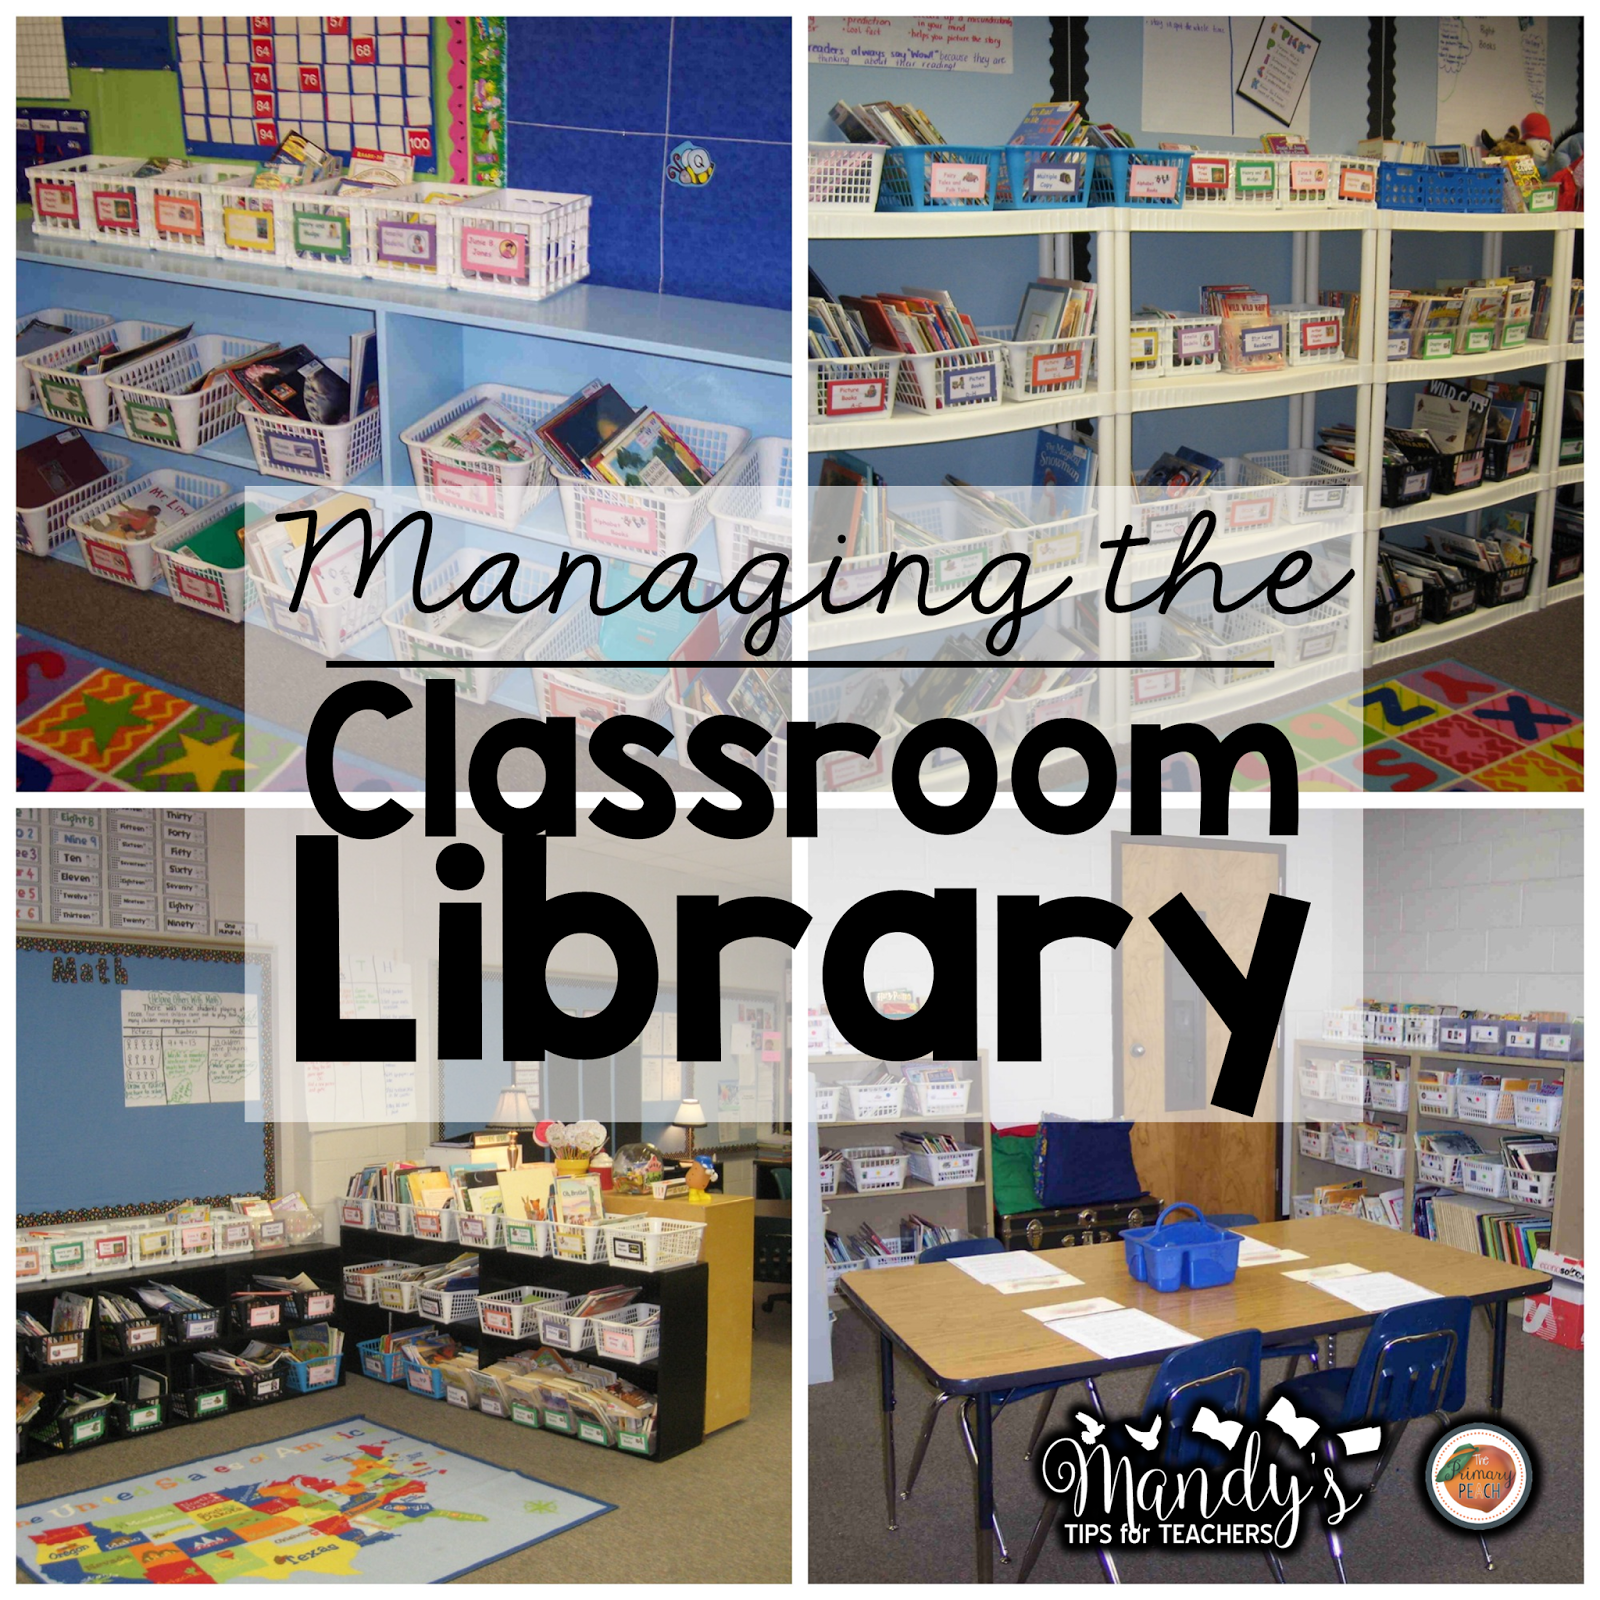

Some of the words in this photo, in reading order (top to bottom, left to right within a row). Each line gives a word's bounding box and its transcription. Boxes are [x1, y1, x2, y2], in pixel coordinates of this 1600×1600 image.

[927, 22, 943, 31] your
[948, 23, 966, 32] mind
[931, 34, 944, 43] you
[255, 45, 271, 58] 64
[356, 44, 372, 57] 68
[808, 43, 844, 55] readers
[851, 46, 886, 60] always
[891, 49, 907, 62] say
[939, 52, 969, 63] because
[973, 53, 990, 67] they
[993, 56, 1007, 64] are
[818, 54, 850, 65] thinking
[864, 56, 888, 66] about
[253, 72, 270, 85] 74
[302, 73, 318, 86] 76
[255, 99, 271, 112] 84
[258, 128, 274, 141] 94
[409, 137, 430, 150] 100
[694, 153, 704, 168] Q
[1036, 172, 1058, 180] Multiple
[1040, 181, 1053, 190] Copy
[472, 248, 492, 257] Jones
[1253, 341, 1272, 349] Readers
[1042, 359, 1060, 367] Picture
[968, 374, 986, 382] Picture
[1429, 379, 1457, 400] WILD
[1040, 450, 1080, 483] Snowman
[60, 812, 87, 827] Eight
[166, 811, 192, 822] Thirty
[120, 823, 145, 833] Fifteen
[27, 829, 34, 839] 2
[168, 829, 191, 840] Forty
[64, 834, 87, 845] Nine
[90, 837, 98, 847] 9
[122, 841, 144, 849] Sixteen
[30, 848, 37, 860] 3
[64, 853, 82, 863] Ten
[170, 847, 192, 859] Fifty
[26, 869, 34, 880] 4
[169, 865, 193, 876] Sixty
[61, 872, 91, 883] Eleven
[166, 882, 193, 892] Seventy
[29, 889, 36, 899] 5
[63, 892, 88, 901] Twelve
[28, 908, 35, 918] 6
[168, 902, 194, 913] Eighty
[62, 911, 91, 920] Thirteen
[122, 916, 146, 925] Twenty
[167, 918, 194, 930] Ninety
[224, 922, 235, 930] One
[218, 928, 242, 936] Hundred
[52, 956, 129, 984] Math
[571, 1189, 588, 1197] Brother
[383, 1502, 432, 1511] Georgia
[49, 1544, 90, 1560] Oregon
[285, 1542, 340, 1567] Texas
